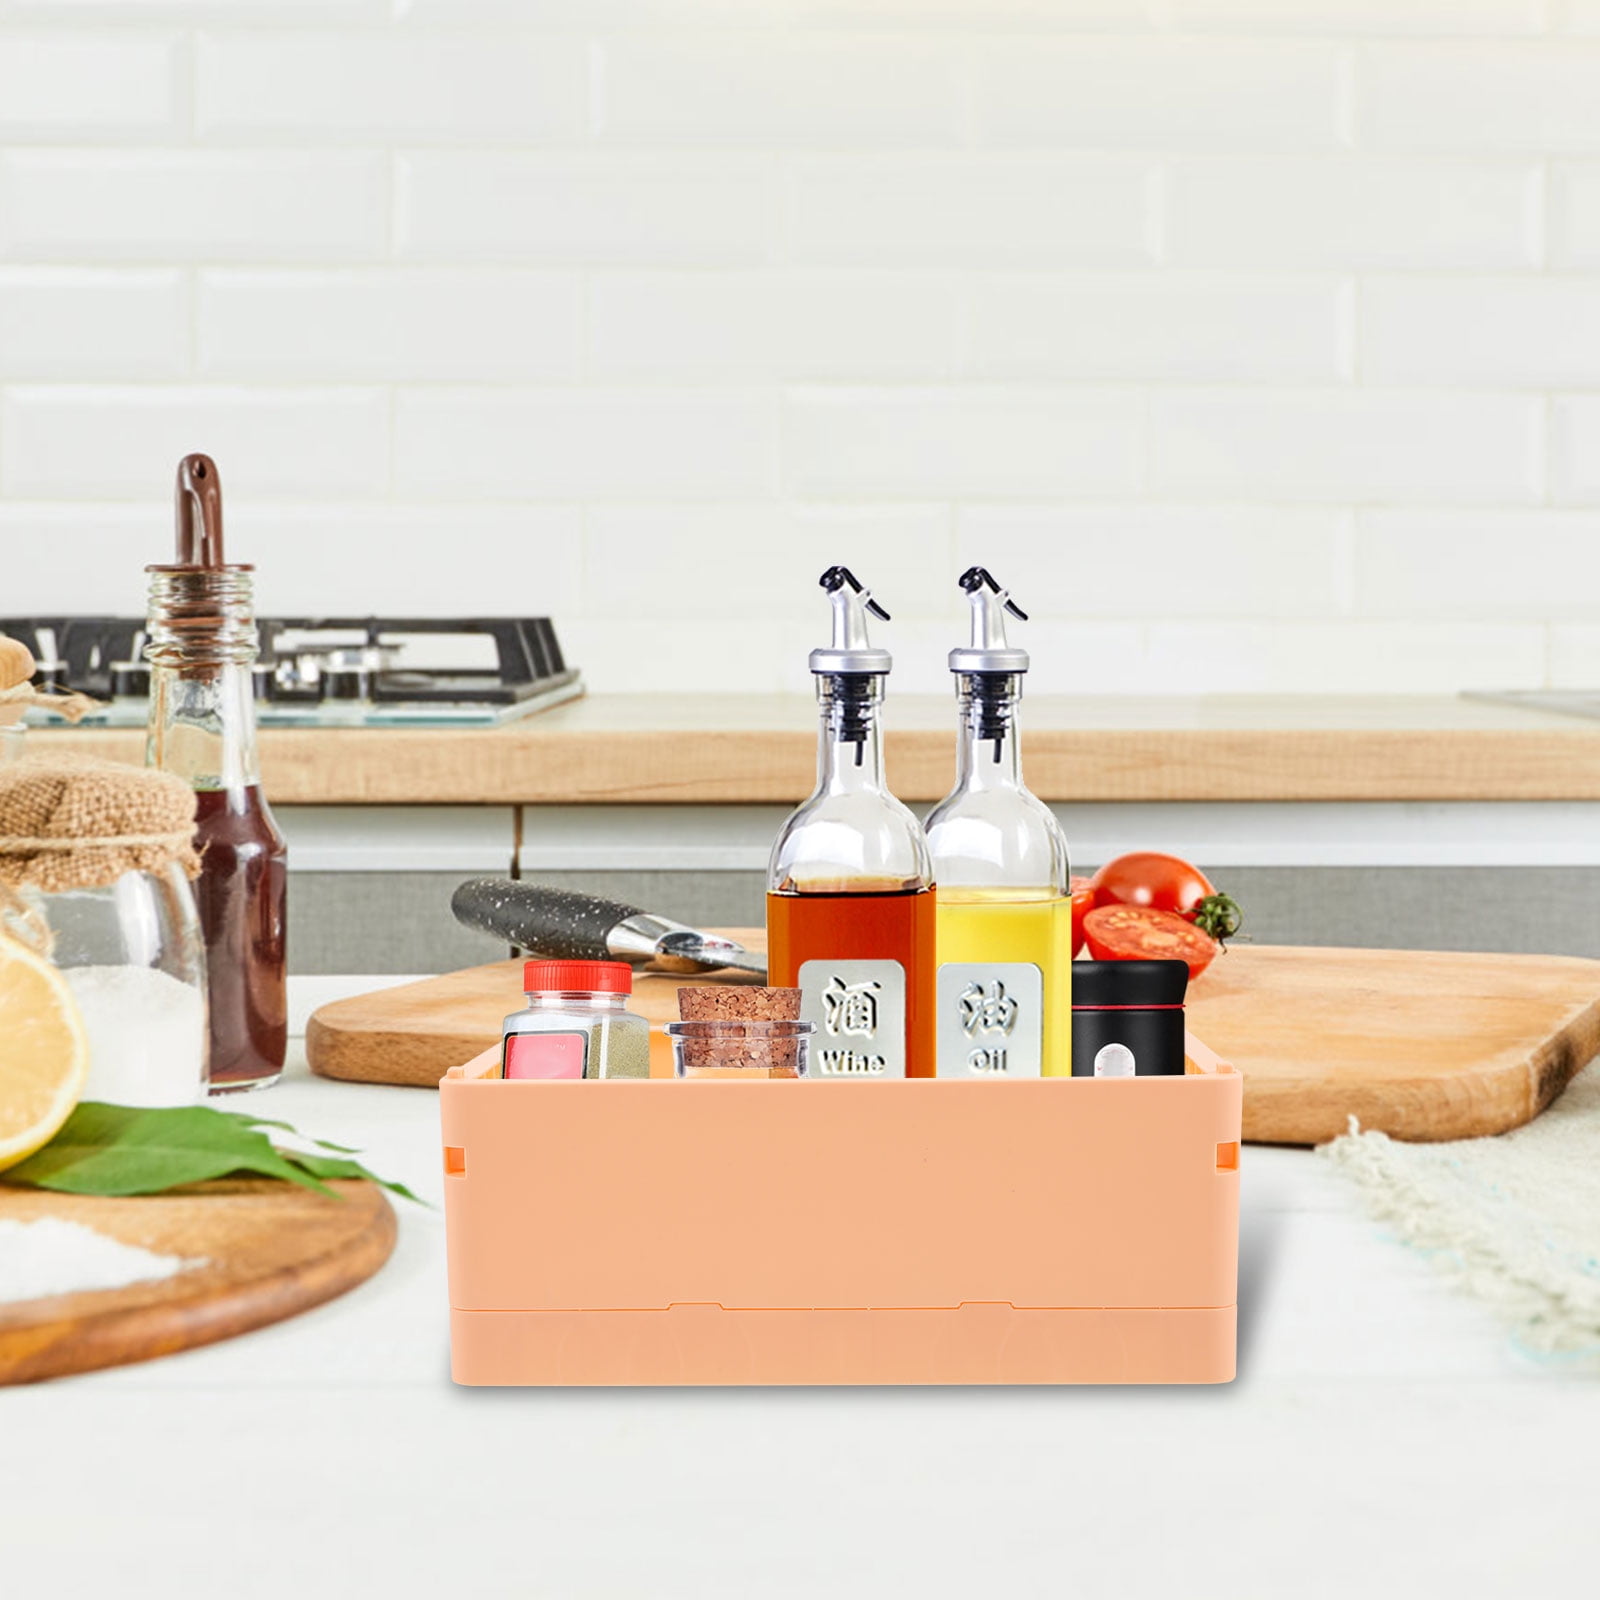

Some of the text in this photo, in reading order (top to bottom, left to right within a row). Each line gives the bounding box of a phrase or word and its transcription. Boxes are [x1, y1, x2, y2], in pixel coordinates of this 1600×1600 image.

[822, 976, 881, 1039] 酒
[958, 979, 1018, 1039] 油
[817, 1049, 888, 1075] Wine
[967, 1048, 1008, 1073] Oil
